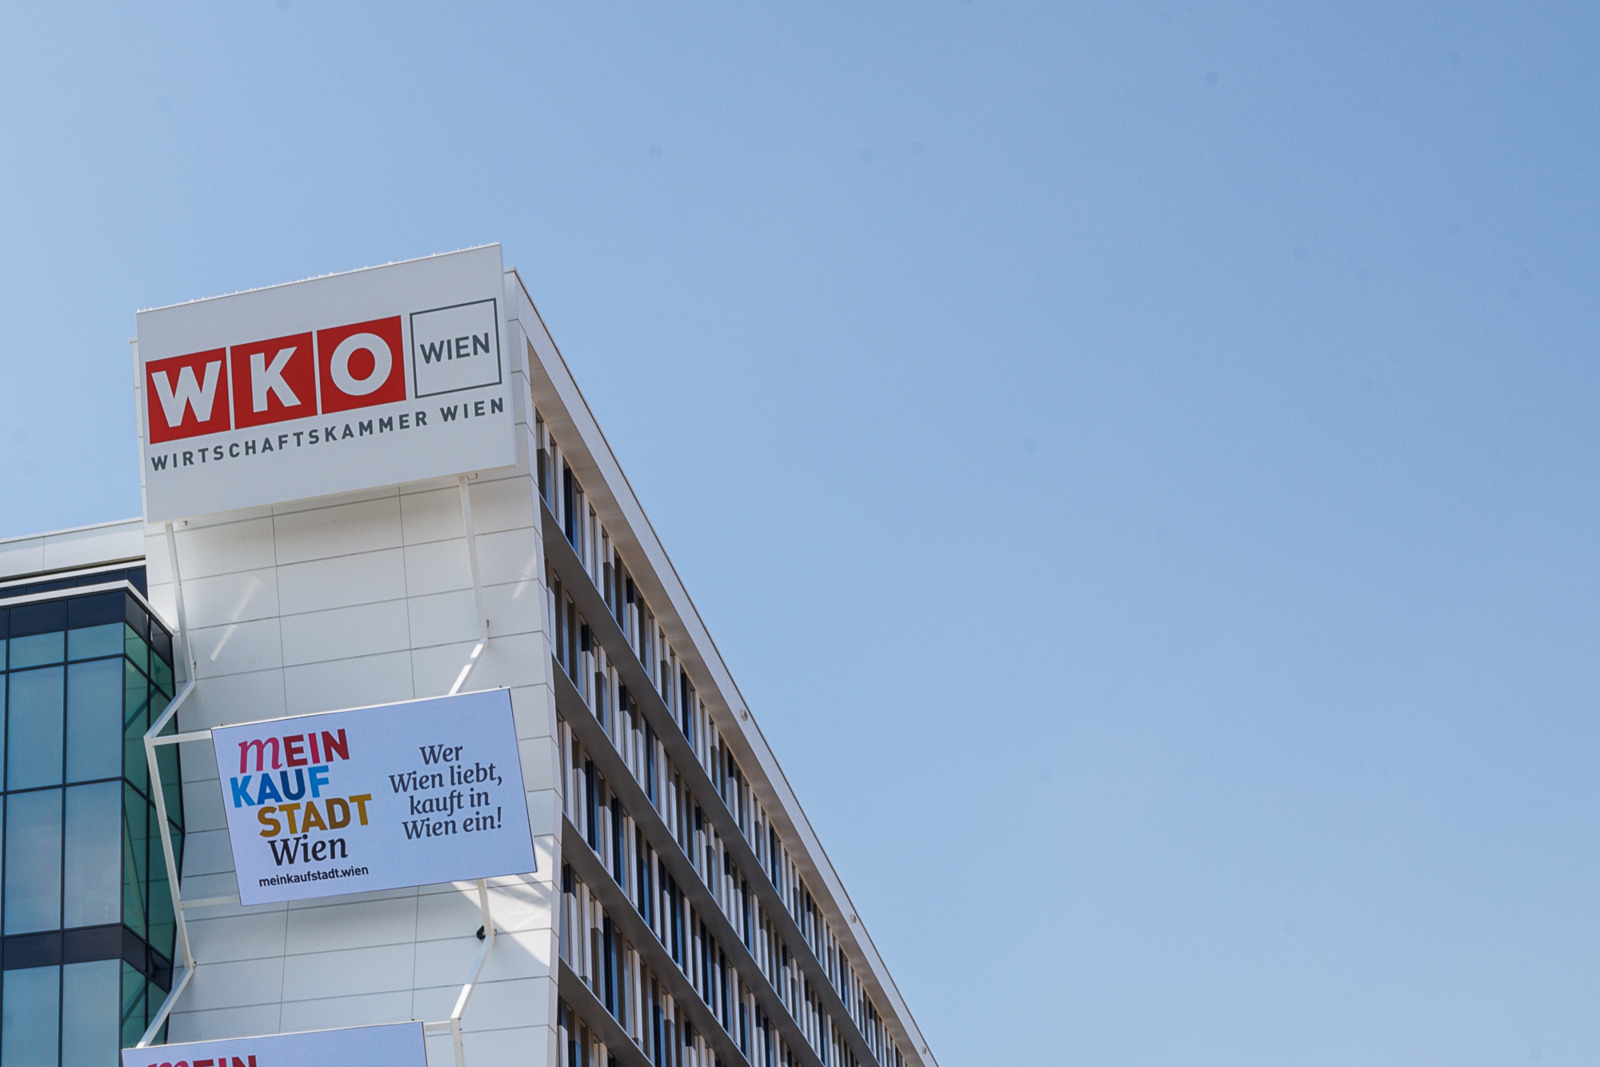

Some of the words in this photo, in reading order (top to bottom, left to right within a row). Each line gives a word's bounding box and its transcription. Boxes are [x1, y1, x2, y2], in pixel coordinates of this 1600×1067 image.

[419, 332, 490, 364] WIEN
[151, 332, 393, 428] WKO
[150, 411, 428, 471] WIRTSCHAFTSKAMMER
[440, 397, 504, 423] WIEN
[419, 744, 464, 766] Wer
[229, 765, 330, 809] KAUF
[388, 770, 444, 794] Wien
[449, 762, 503, 787] liebt,
[257, 793, 372, 838] STADT
[409, 790, 465, 818] kauft
[469, 788, 490, 807] in
[402, 816, 457, 840] Wien
[462, 806, 503, 831] ein!
[268, 834, 348, 867] Wien
[258, 864, 369, 888] meinkaufstadt.wien
